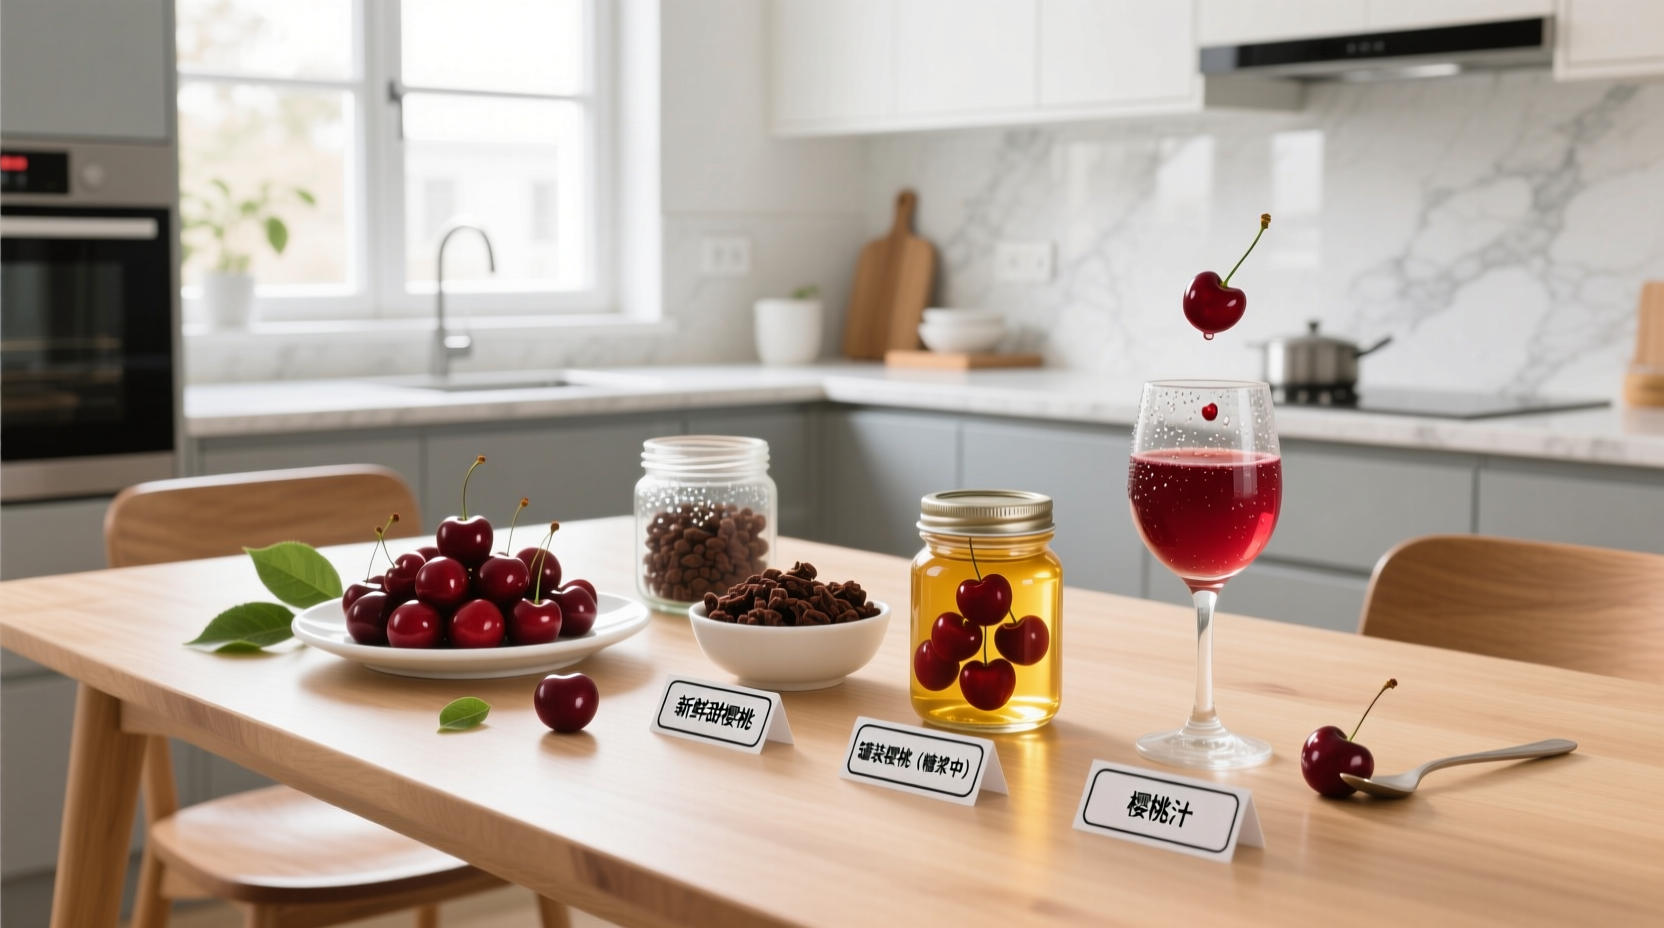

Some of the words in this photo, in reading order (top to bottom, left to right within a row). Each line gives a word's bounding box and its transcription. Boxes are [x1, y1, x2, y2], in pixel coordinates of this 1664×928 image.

[674, 694, 755, 730] 新鲜甜樱桃
[1126, 790, 1193, 828] 樱桃汁
